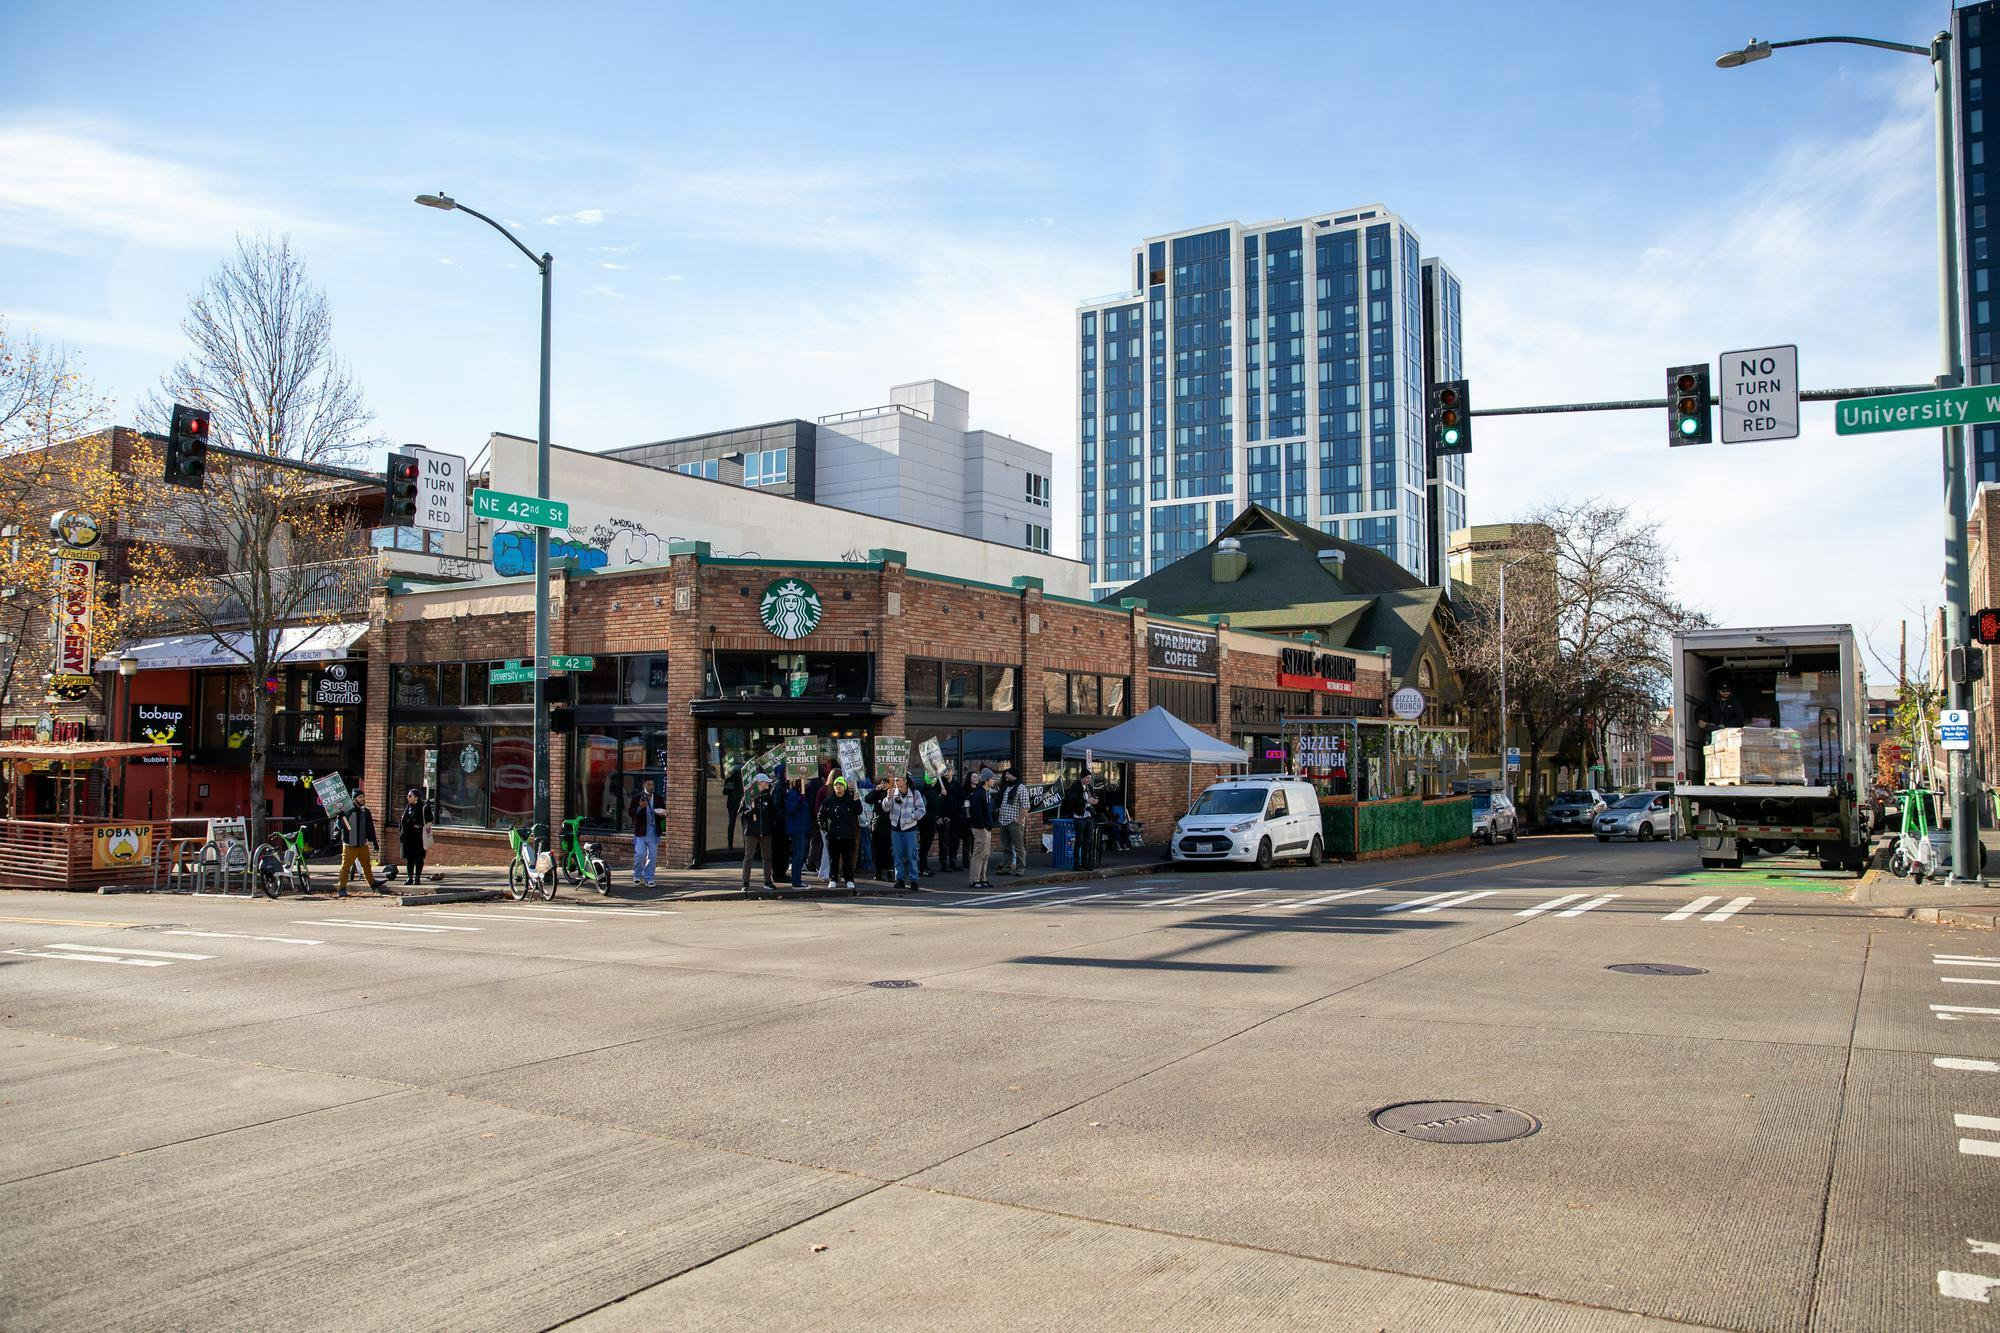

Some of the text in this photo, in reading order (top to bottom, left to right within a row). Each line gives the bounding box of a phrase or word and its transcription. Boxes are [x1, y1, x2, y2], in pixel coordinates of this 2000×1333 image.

[1740, 357, 1776, 377] NO
[1735, 379, 1781, 396] TURN
[1747, 399, 1770, 413] ON
[1843, 398, 1969, 427] University
[1743, 417, 1776, 433] RED
[428, 459, 452, 477] NO
[424, 477, 454, 493] TURN
[431, 494, 447, 507] ON
[428, 510, 450, 523] RED
[479, 497, 562, 522] NE 42nd St
[1154, 632, 1207, 653] STARBUCKS
[551, 659, 560, 667] NE
[565, 658, 579, 669] 42
[1164, 650, 1198, 667] COFFEE
[491, 670, 518, 682] University
[320, 679, 358, 692] Sushi
[317, 690, 361, 704] Burrito
[139, 706, 183, 724] bobaup
[786, 744, 817, 752] BARISTAS
[876, 744, 906, 752] BARISTAS
[1300, 736, 1339, 750] SIZZLE
[786, 755, 817, 764] STRIKE!
[876, 755, 905, 763] STRIKE!
[1300, 752, 1345, 767] CRUNCH
[322, 790, 348, 806] STRIKE!
[1029, 786, 1044, 798] FAIR
[1043, 792, 1062, 807] NOW!
[97, 827, 150, 838] BOBA UP
